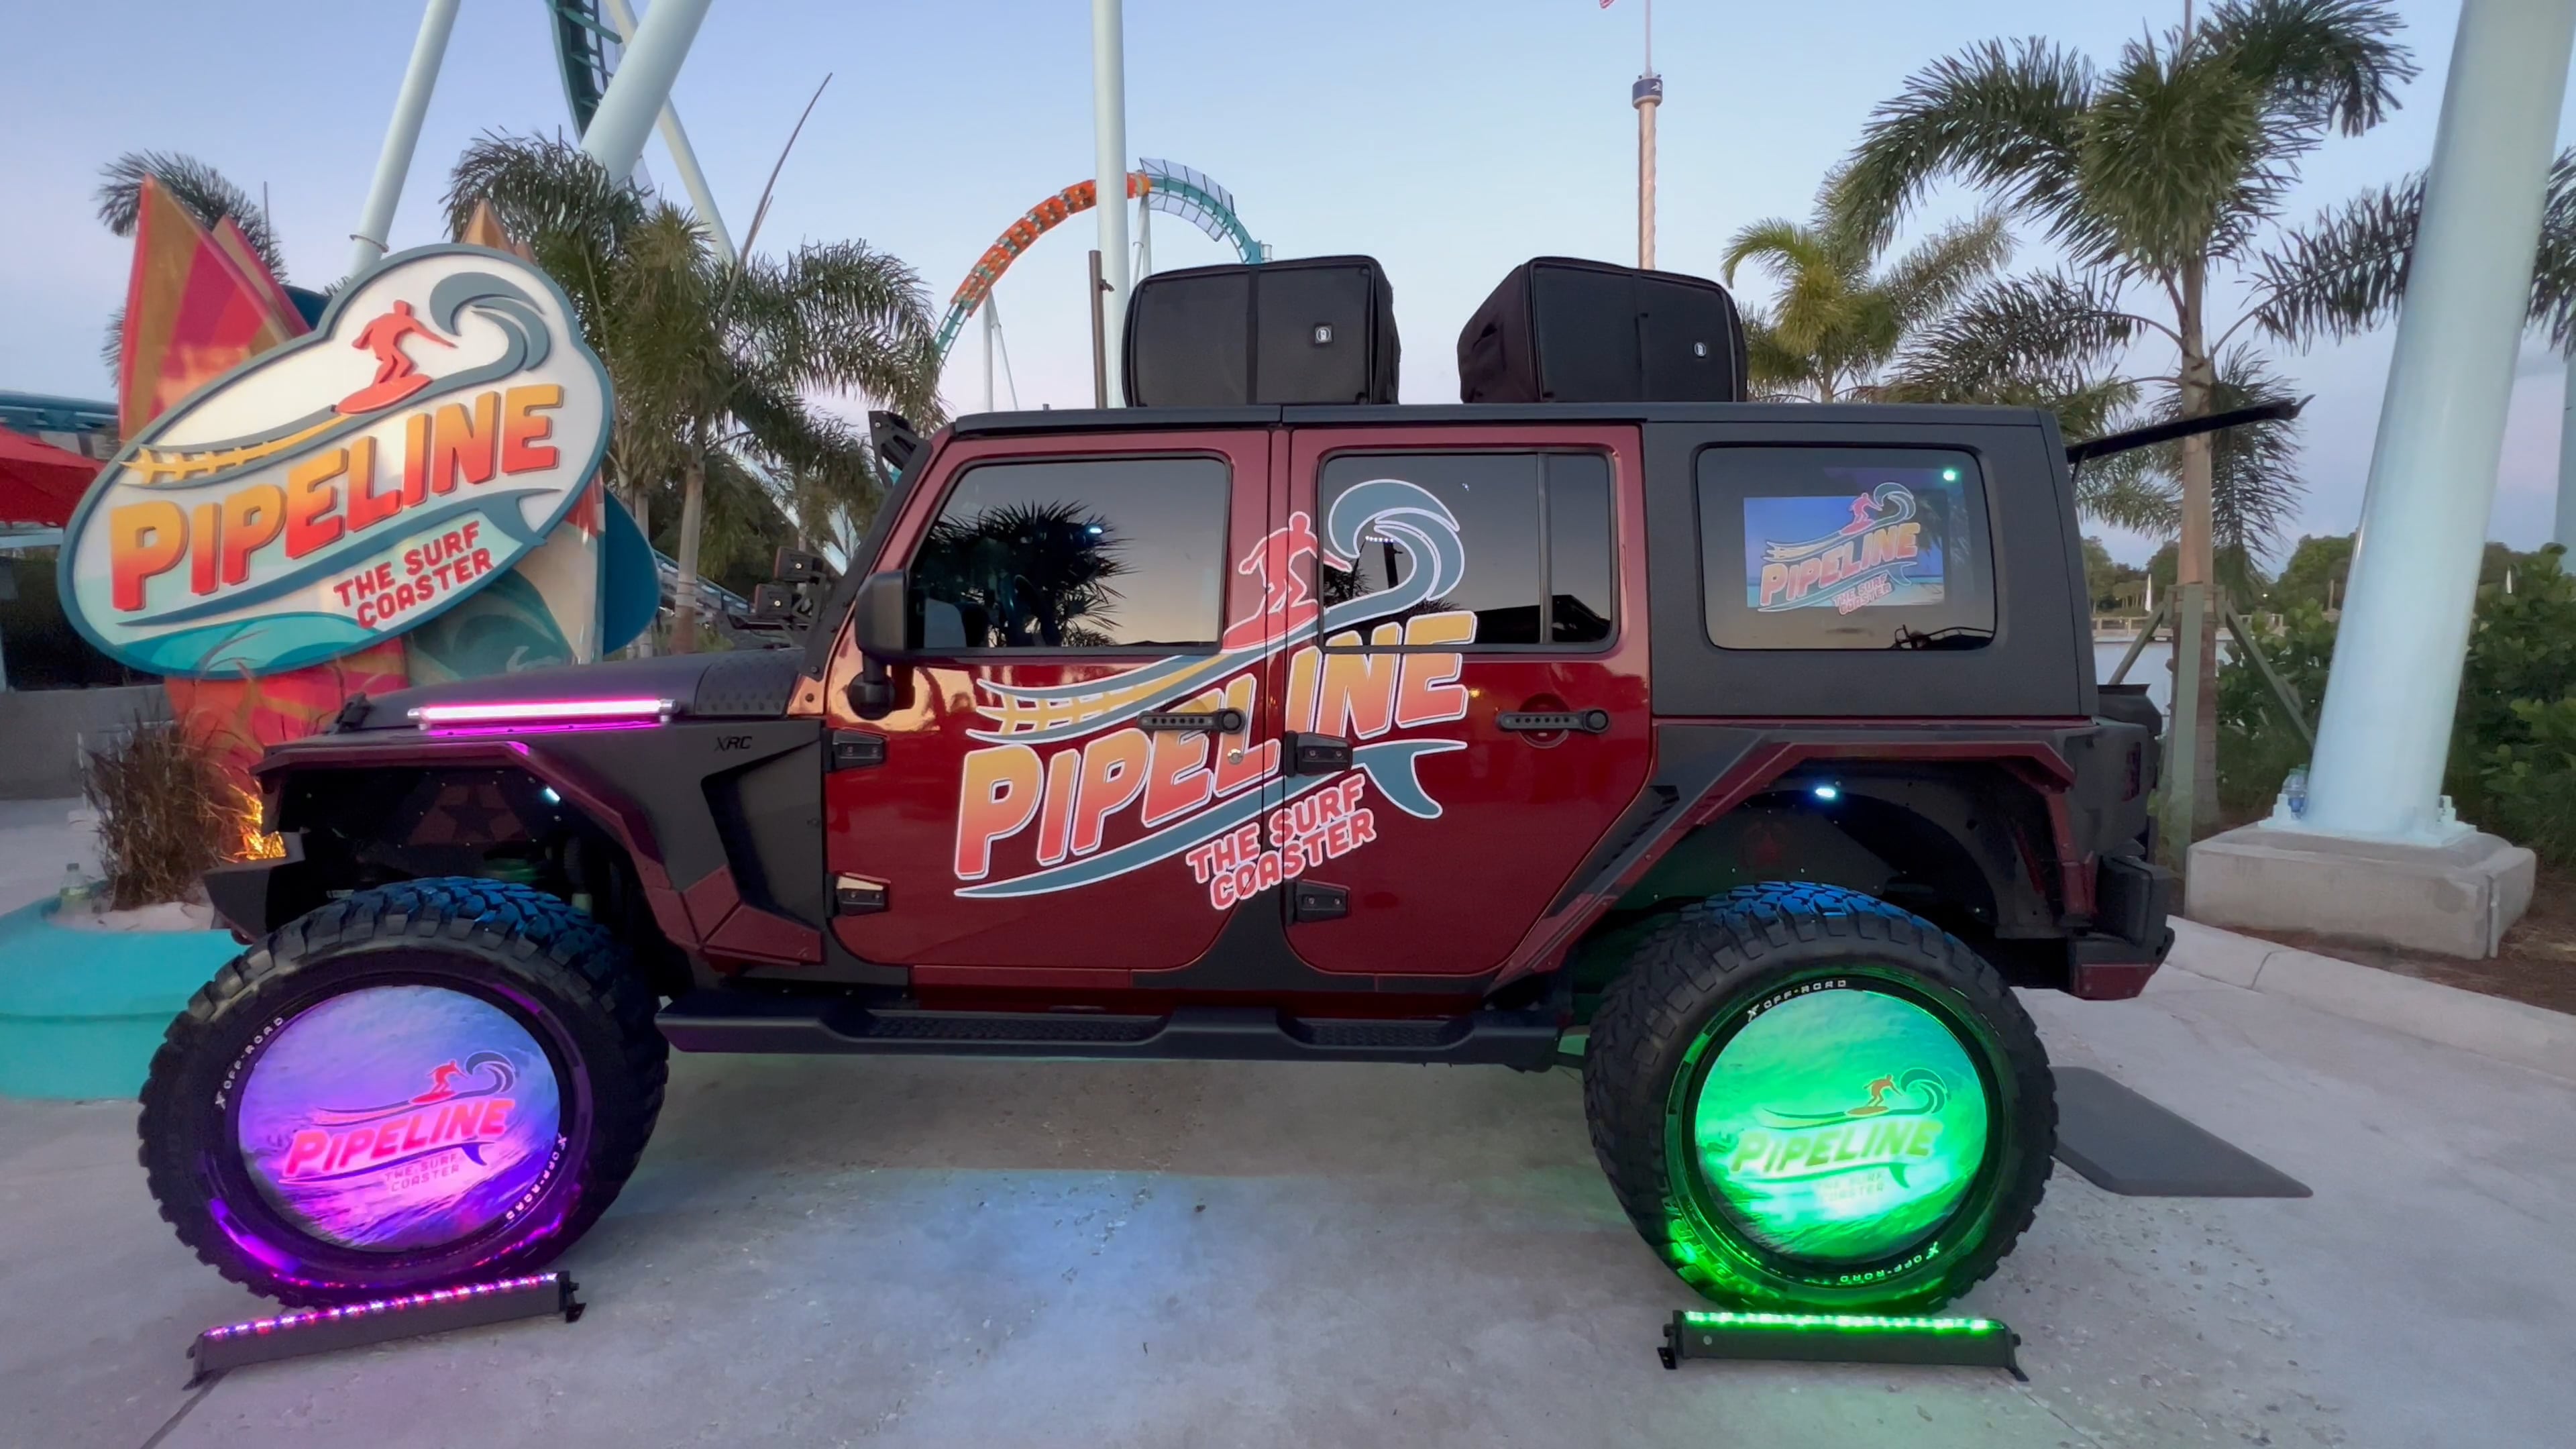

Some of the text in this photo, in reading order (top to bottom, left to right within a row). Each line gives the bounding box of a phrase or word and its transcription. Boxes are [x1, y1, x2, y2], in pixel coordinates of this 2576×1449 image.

[109, 384, 565, 612] PIPELINE
[333, 520, 480, 608] THE SURF
[357, 547, 494, 629] COASTER
[1759, 521, 1921, 606] PIPELINE
[1831, 573, 1888, 608] THE SURF
[714, 735, 753, 752] XRC
[955, 610, 1478, 880] PIPELINE
[1186, 773, 1366, 884] THE SURF
[1210, 807, 1377, 910] COASTER
[1763, 979, 1847, 1010] OFF-ROAD
[223, 1017, 284, 1089] OFF-ROAD
[284, 1098, 516, 1178] PIPELINE
[384, 1154, 459, 1182] THE SURF
[1730, 1120, 1944, 1173] PIPELINE
[390, 1164, 460, 1192] COASTER
[505, 1150, 560, 1220] OFF-ROAD
[1839, 1254, 1923, 1283] OFF-ROAD
